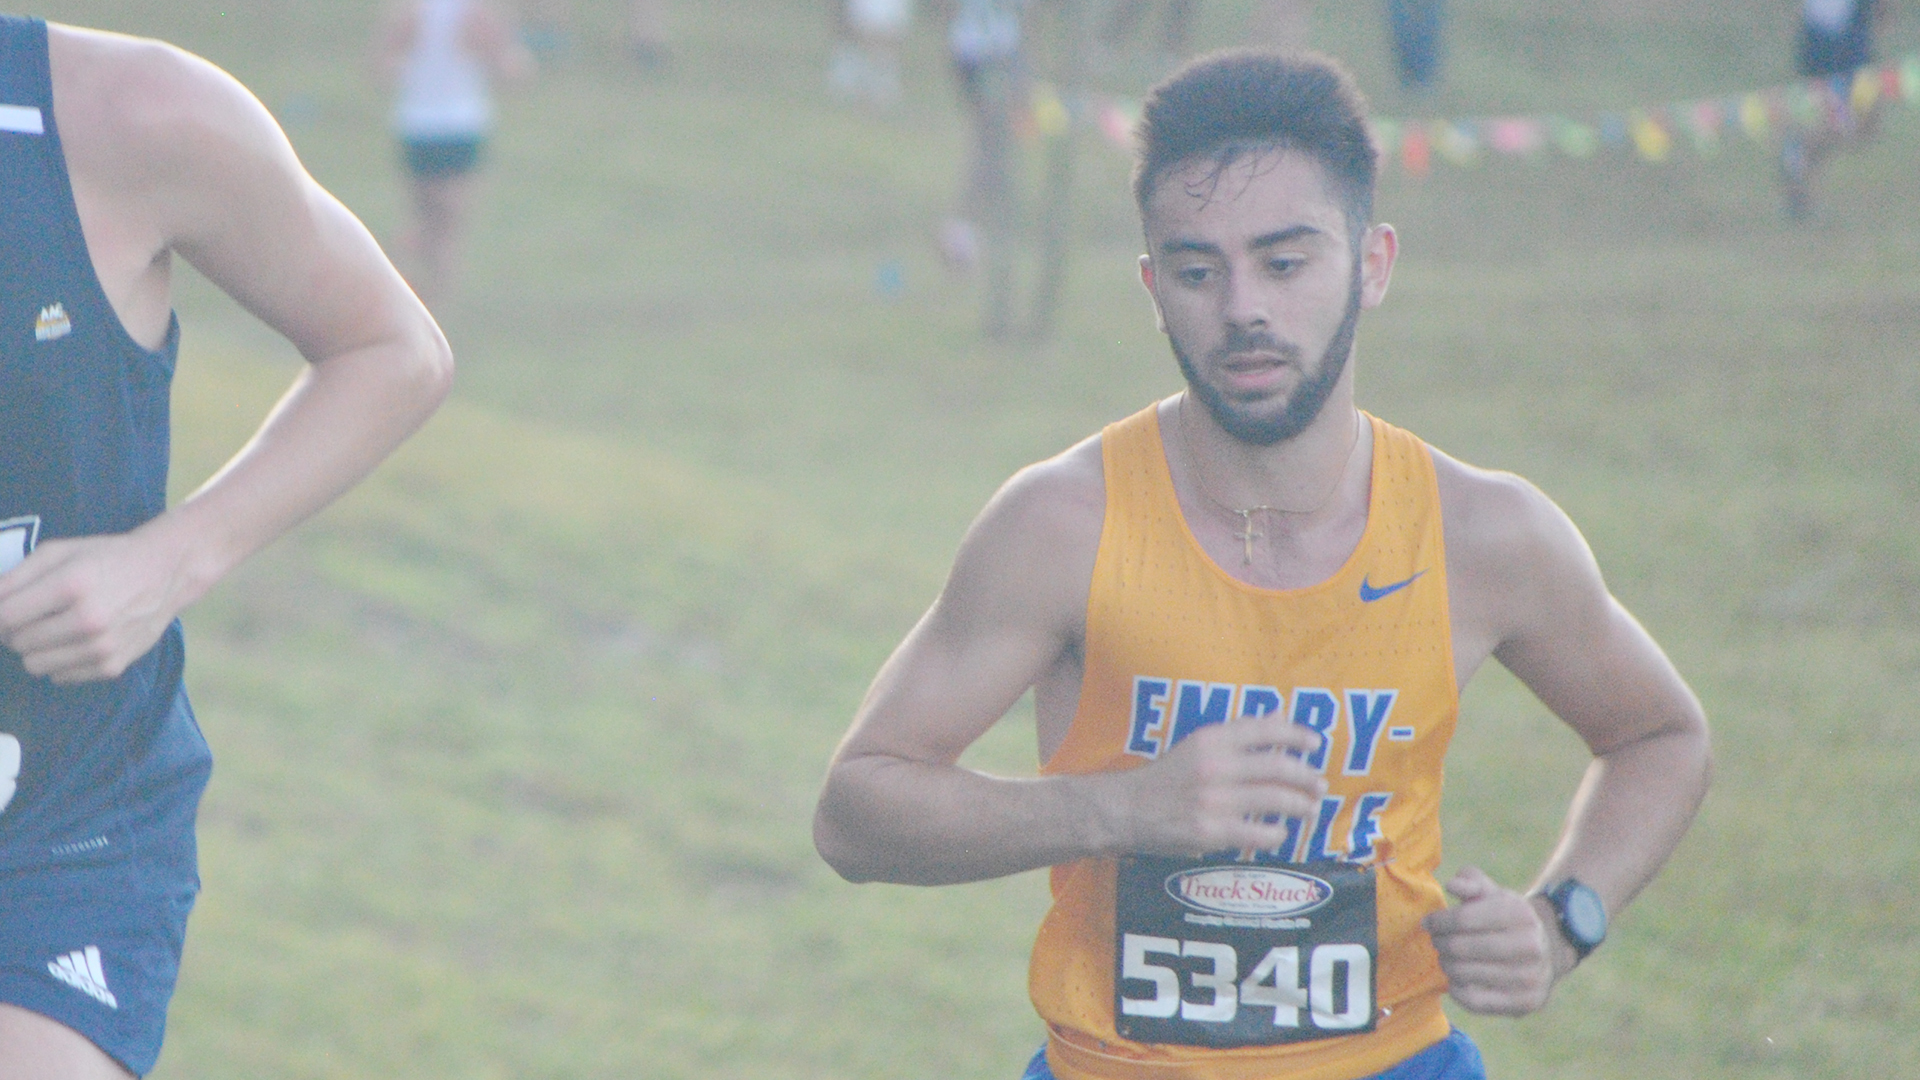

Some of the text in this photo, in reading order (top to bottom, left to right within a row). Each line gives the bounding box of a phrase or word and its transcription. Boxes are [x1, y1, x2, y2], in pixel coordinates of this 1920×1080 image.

[1180, 874, 1322, 902] Track Shack
[1121, 932, 1371, 1029] 5340
